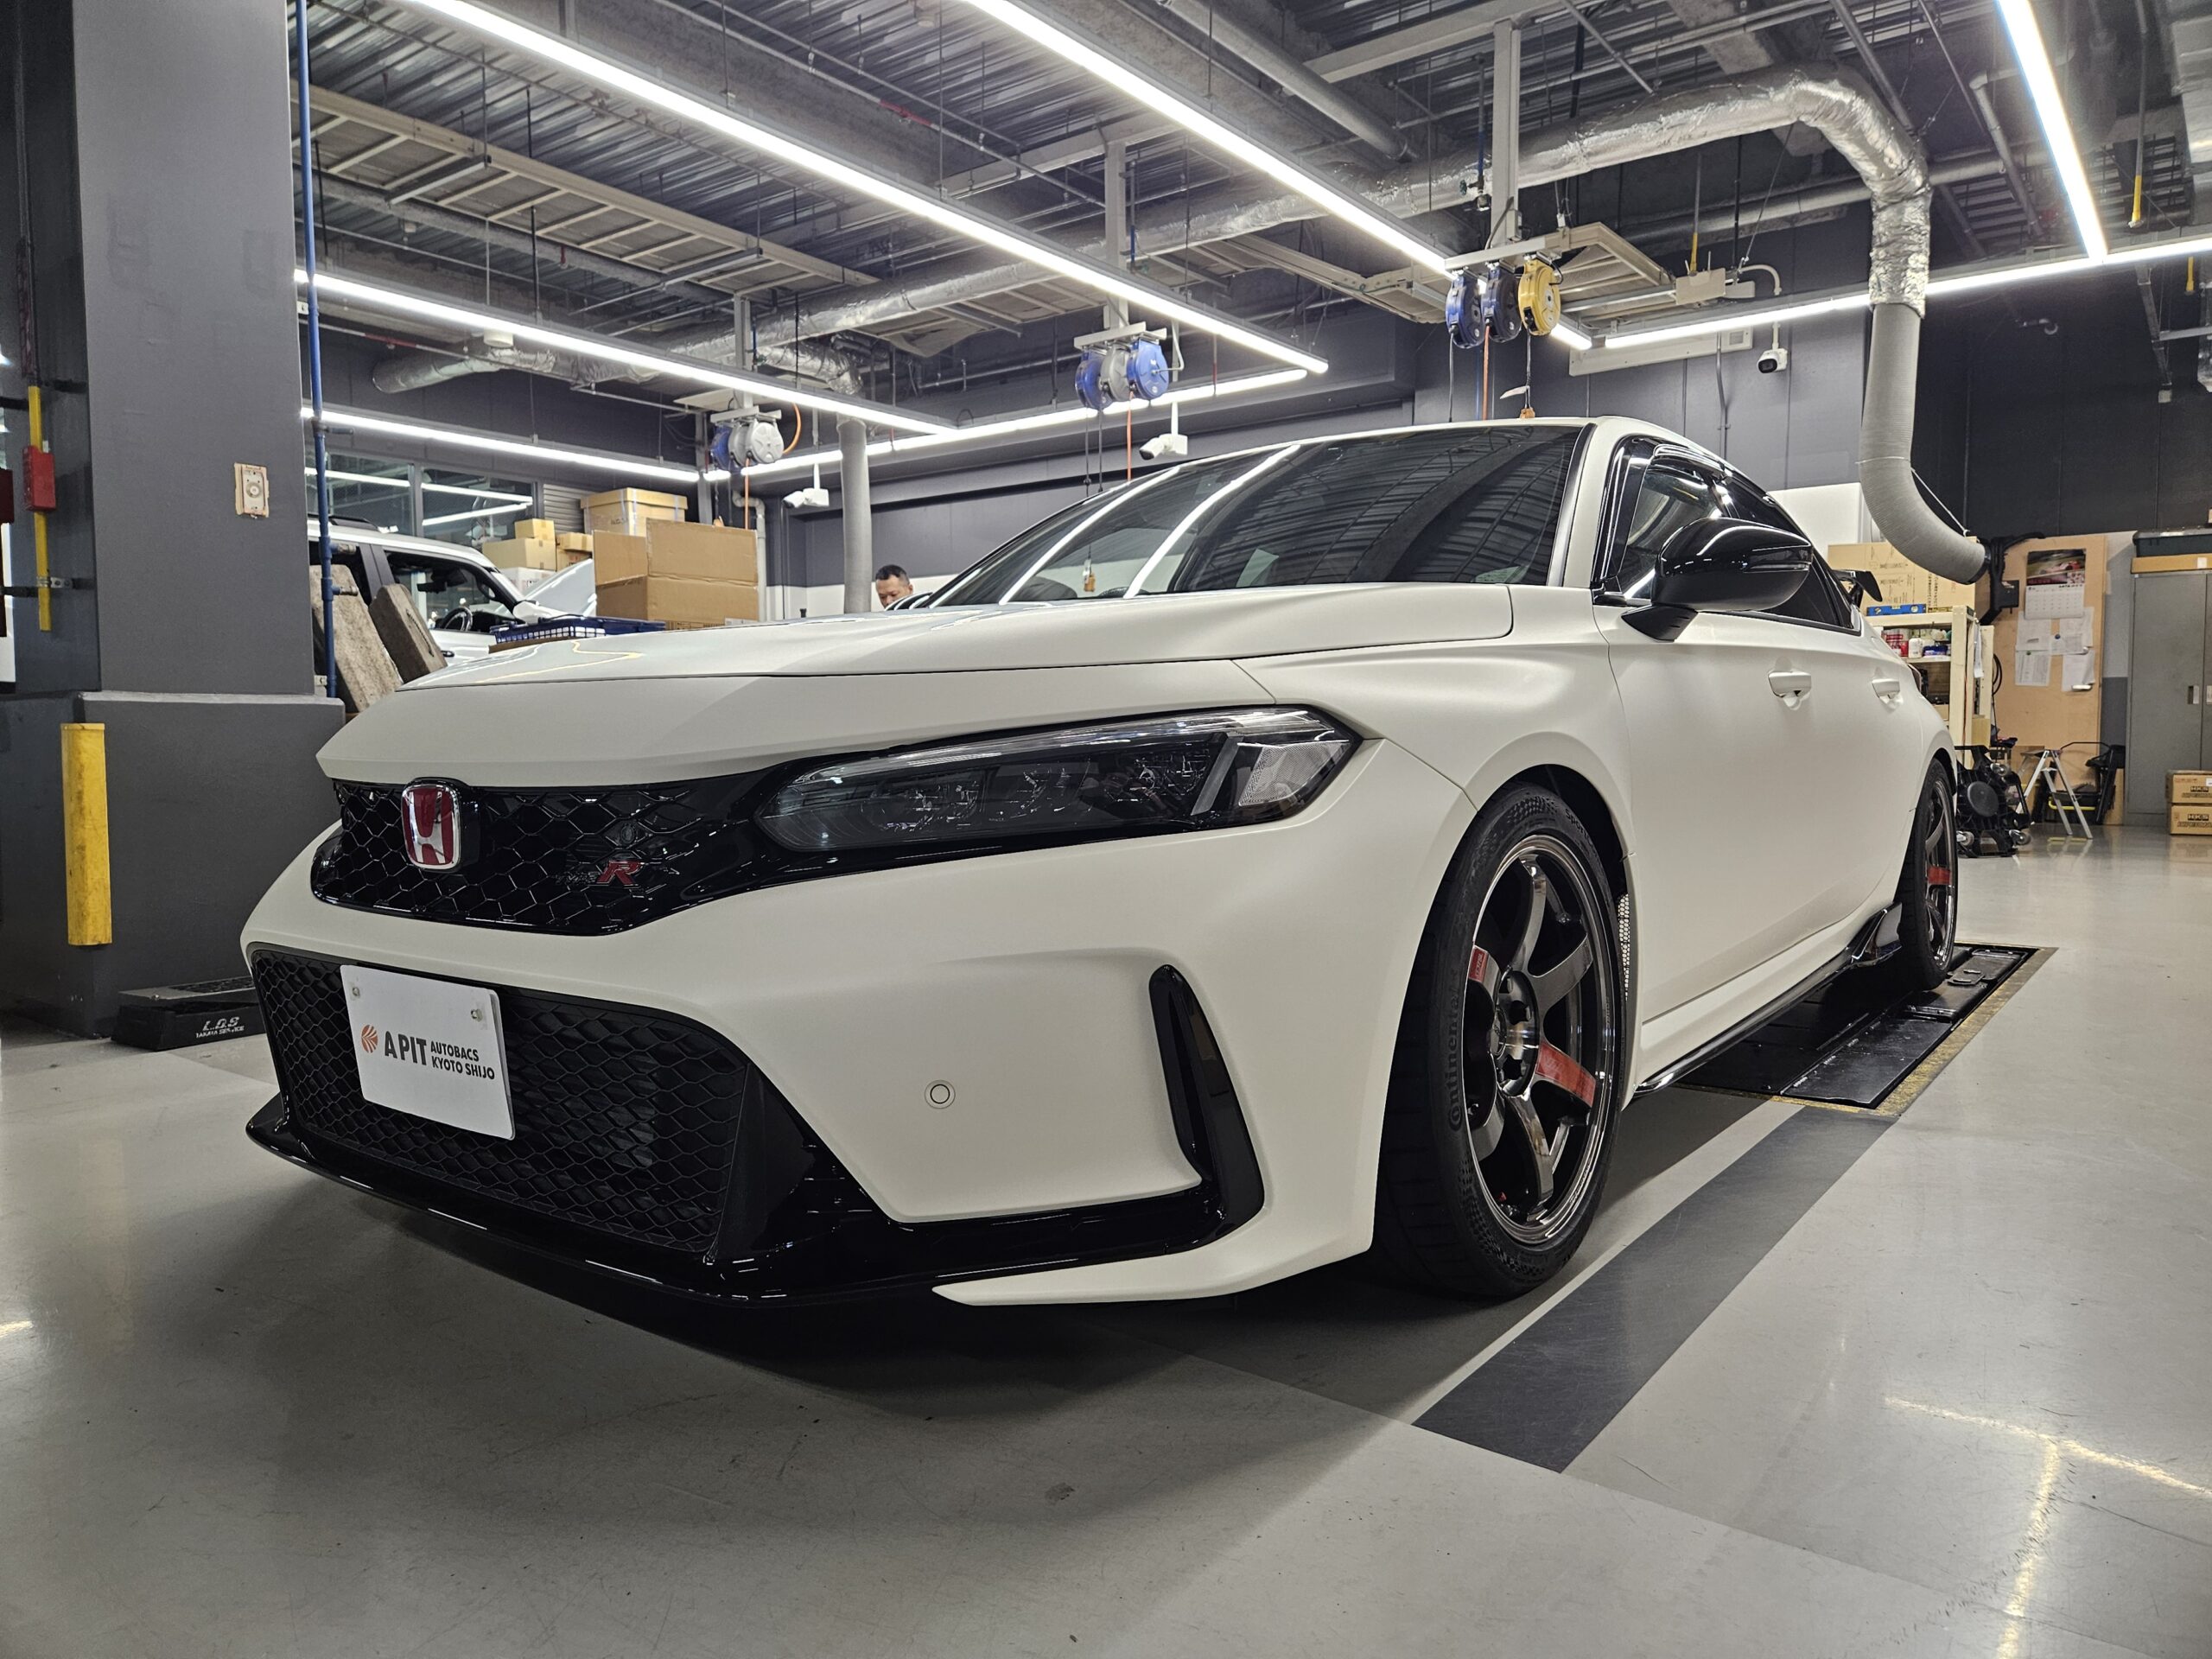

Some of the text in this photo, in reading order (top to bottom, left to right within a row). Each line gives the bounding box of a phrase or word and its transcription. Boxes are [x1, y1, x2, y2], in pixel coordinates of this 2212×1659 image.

[430, 1040, 480, 1062] AUTOBACS
[431, 1055, 495, 1080] KYOTO SHIJO
